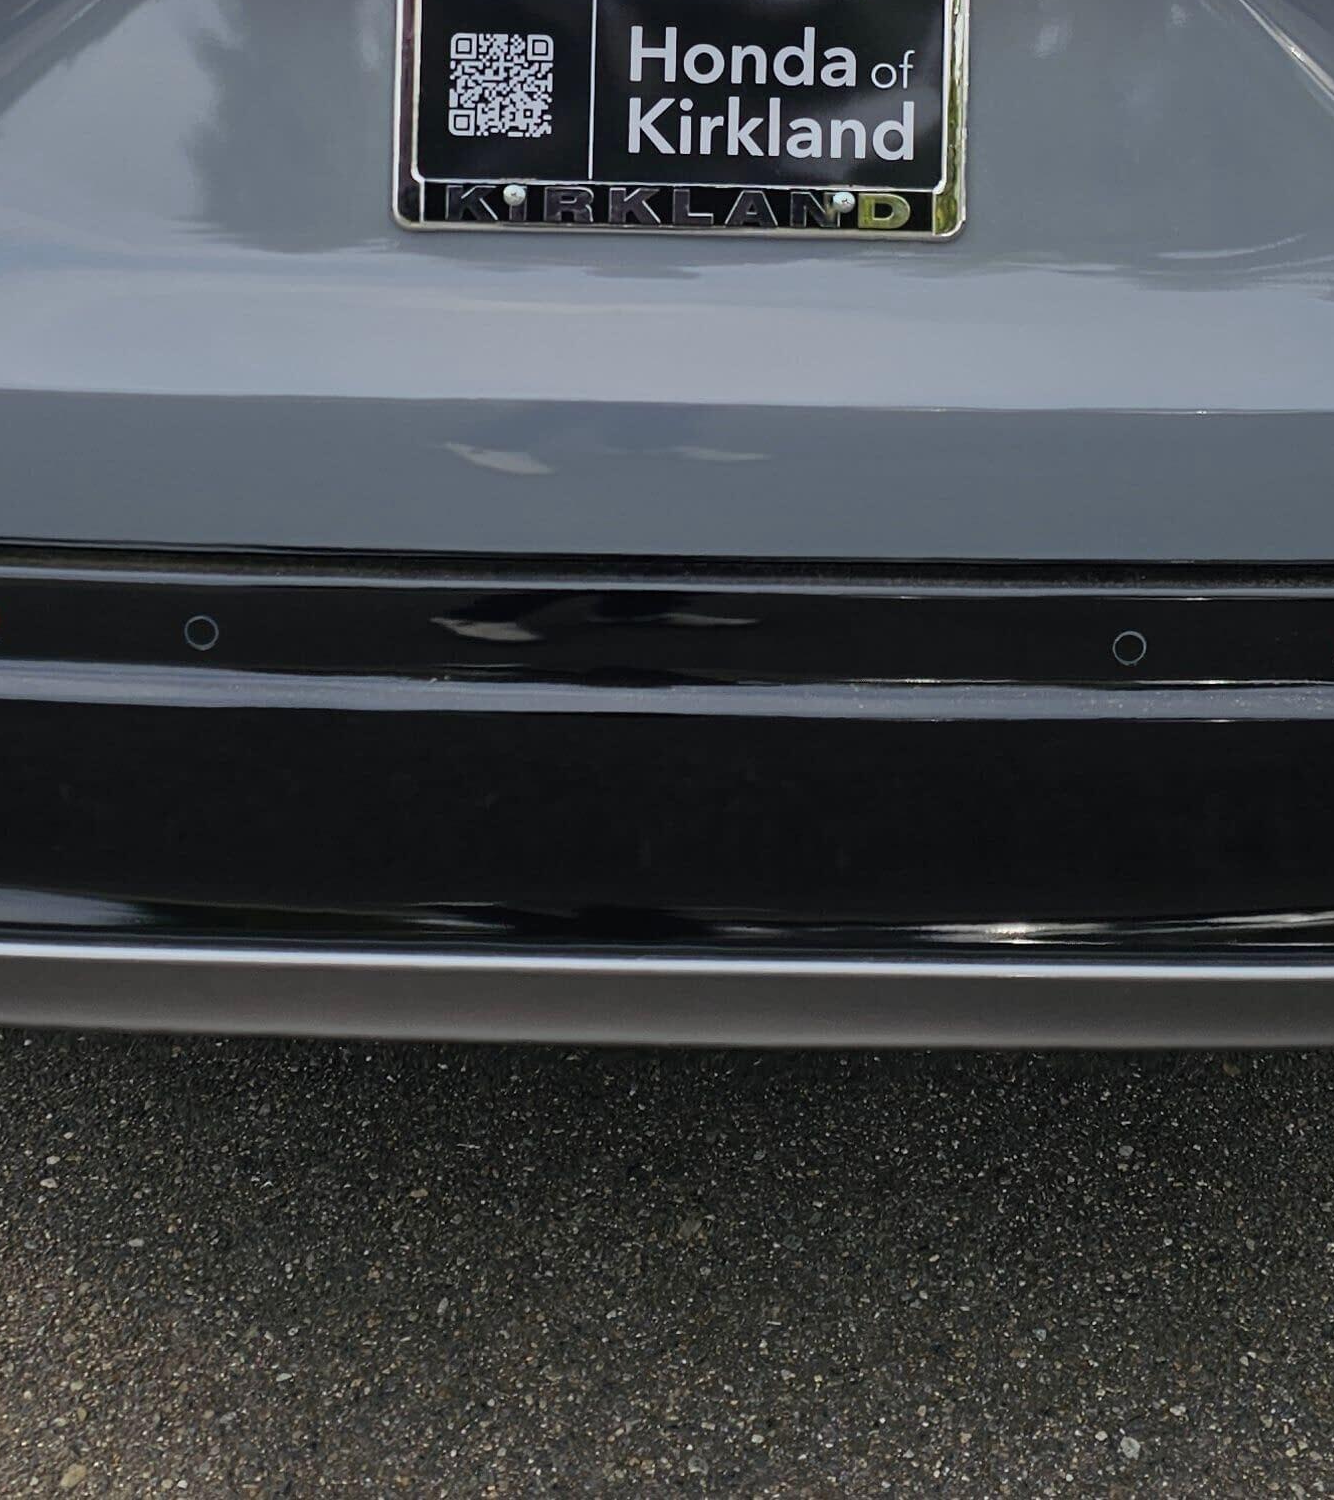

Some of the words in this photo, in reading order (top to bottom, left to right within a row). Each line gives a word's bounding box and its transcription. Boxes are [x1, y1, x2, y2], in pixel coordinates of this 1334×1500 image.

[629, 25, 857, 87] Honda
[870, 49, 915, 90] of
[627, 97, 915, 161] Kirkland
[445, 184, 911, 230] KIRKLAND
